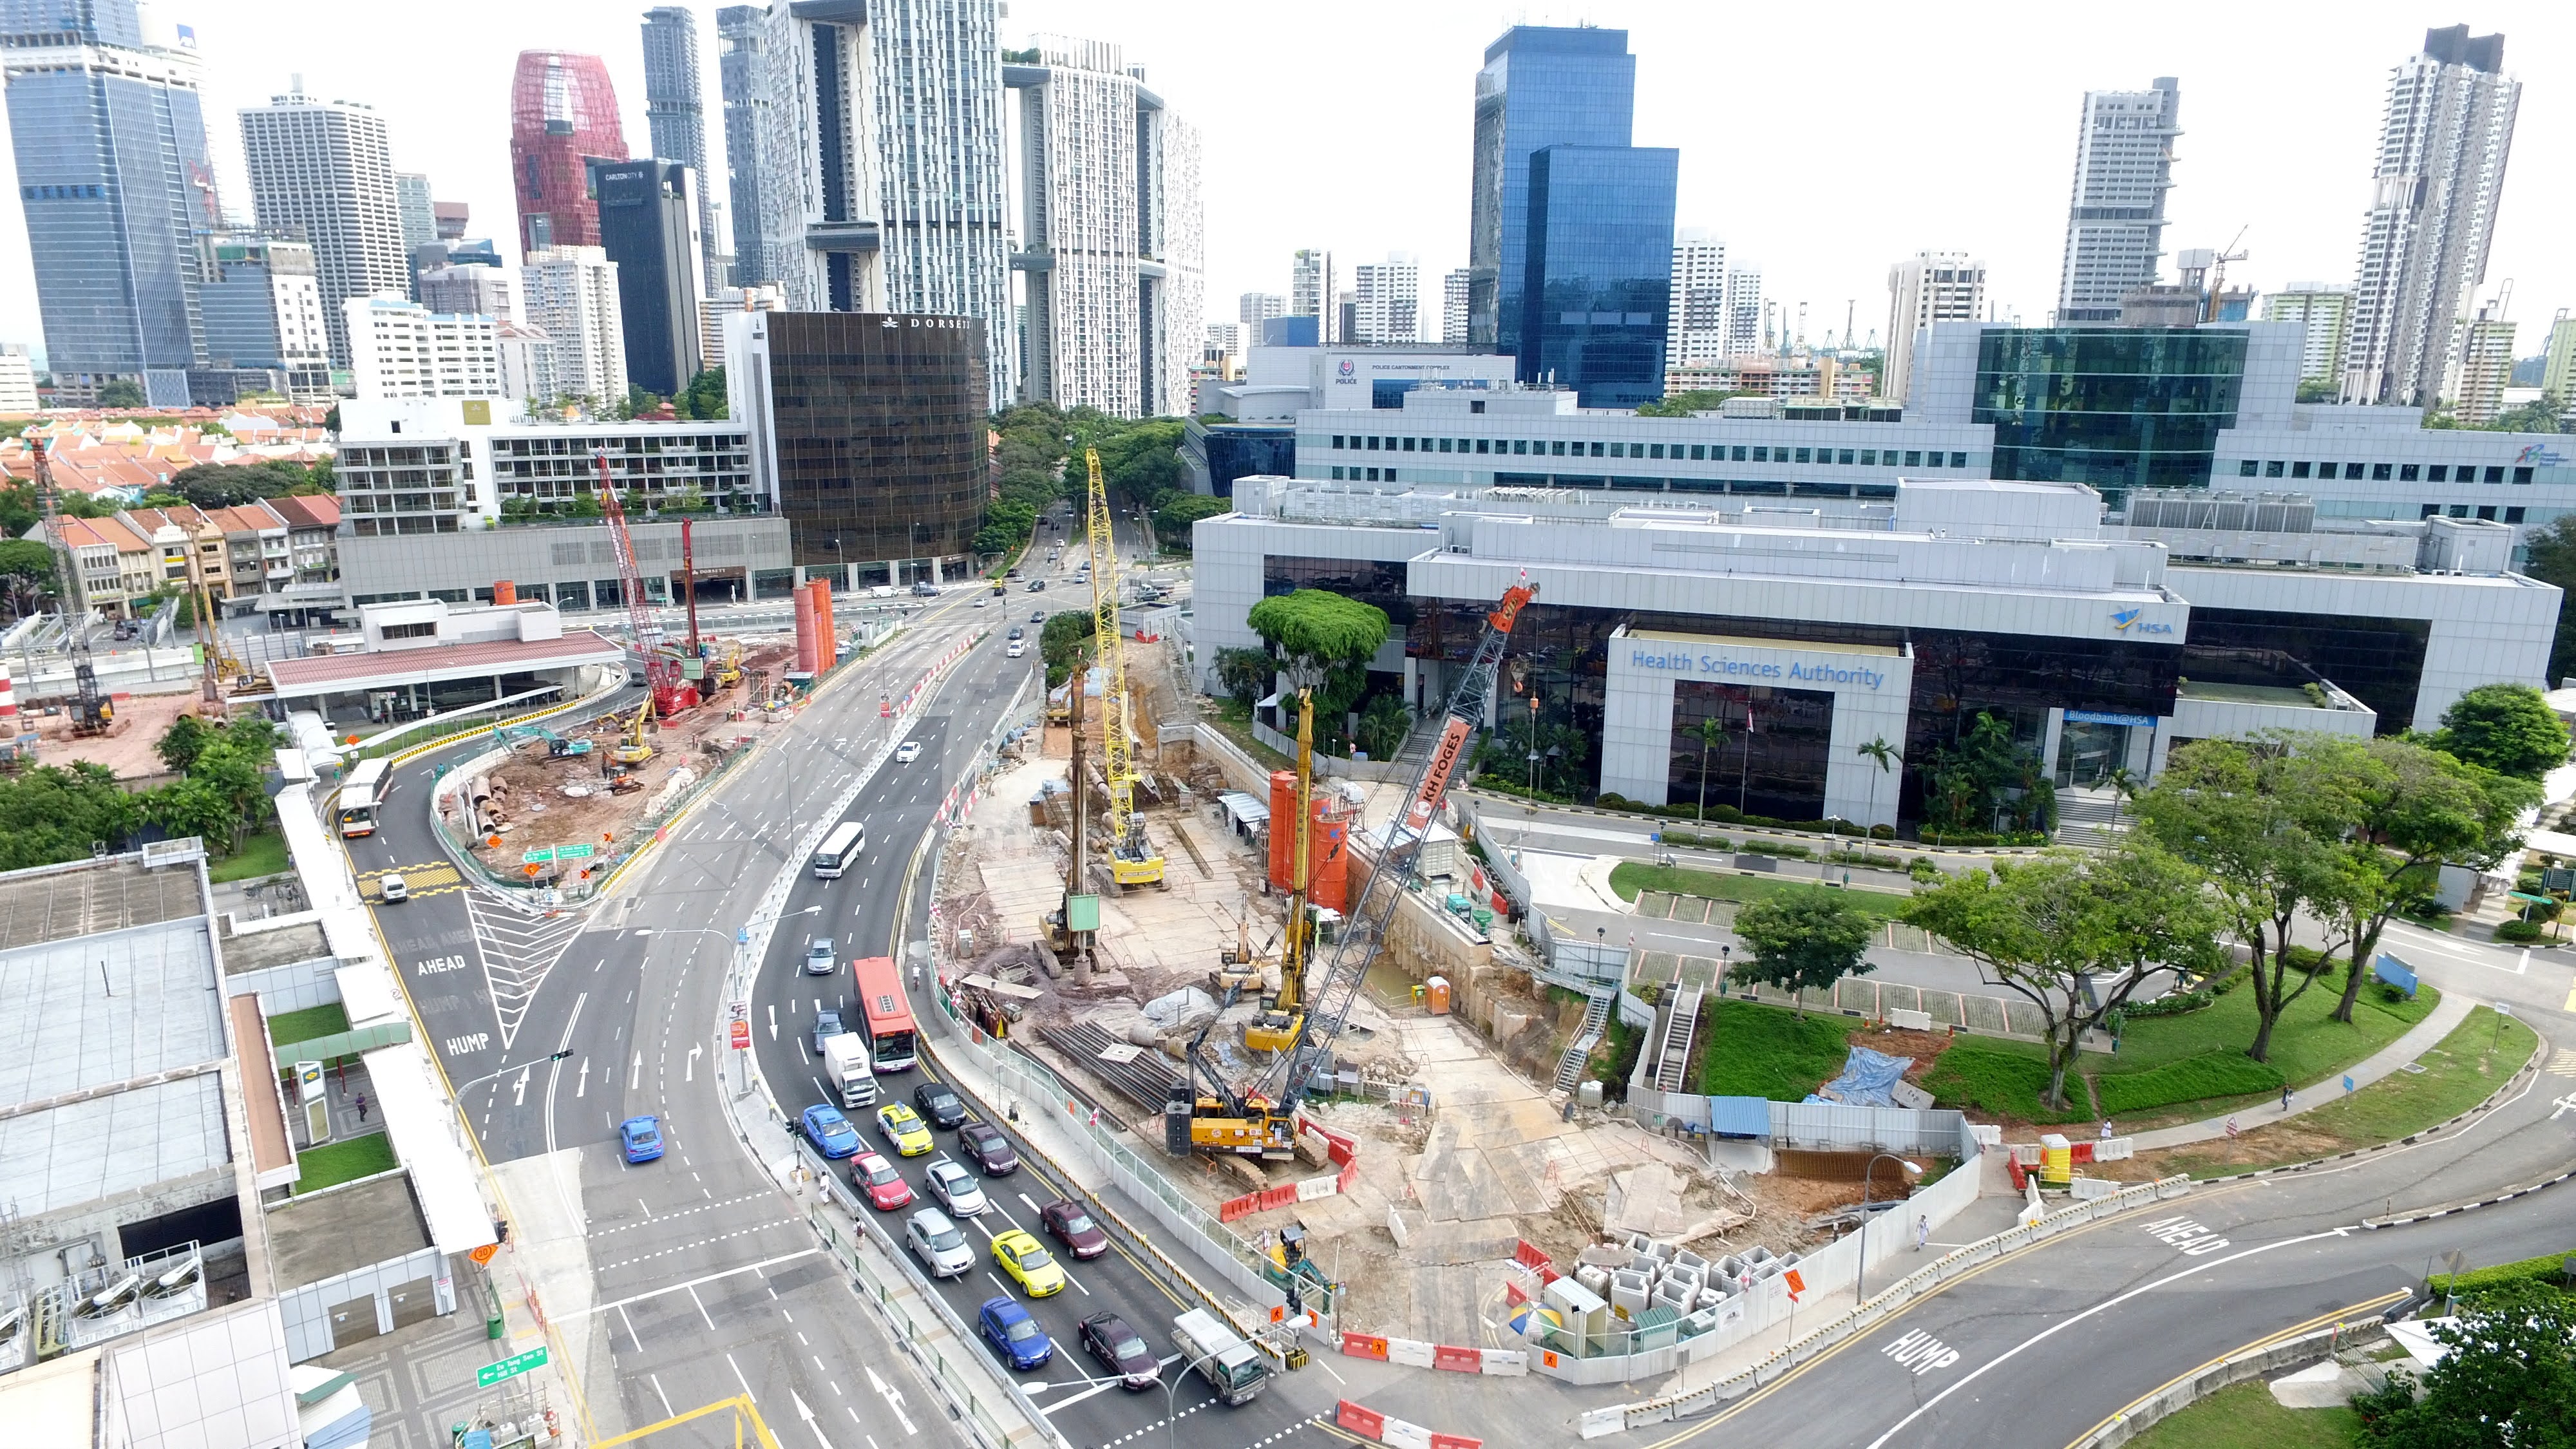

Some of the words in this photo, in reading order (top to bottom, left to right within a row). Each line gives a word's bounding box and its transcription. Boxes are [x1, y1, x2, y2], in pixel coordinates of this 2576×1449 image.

[2138, 622, 2173, 634] HSA
[1633, 650, 1692, 671] Health
[1700, 655, 1781, 678] Sciences
[1789, 661, 1885, 690] Authority
[2069, 710, 2149, 725] Bloodbank@HSA
[1423, 780, 1439, 802] KH
[1434, 732, 1461, 779] FOGES
[419, 955, 466, 976] AHEAD
[446, 1032, 489, 1056] HUMP
[2138, 1215, 2230, 1256] AHEAD
[1880, 1327, 1960, 1376] HUMP
